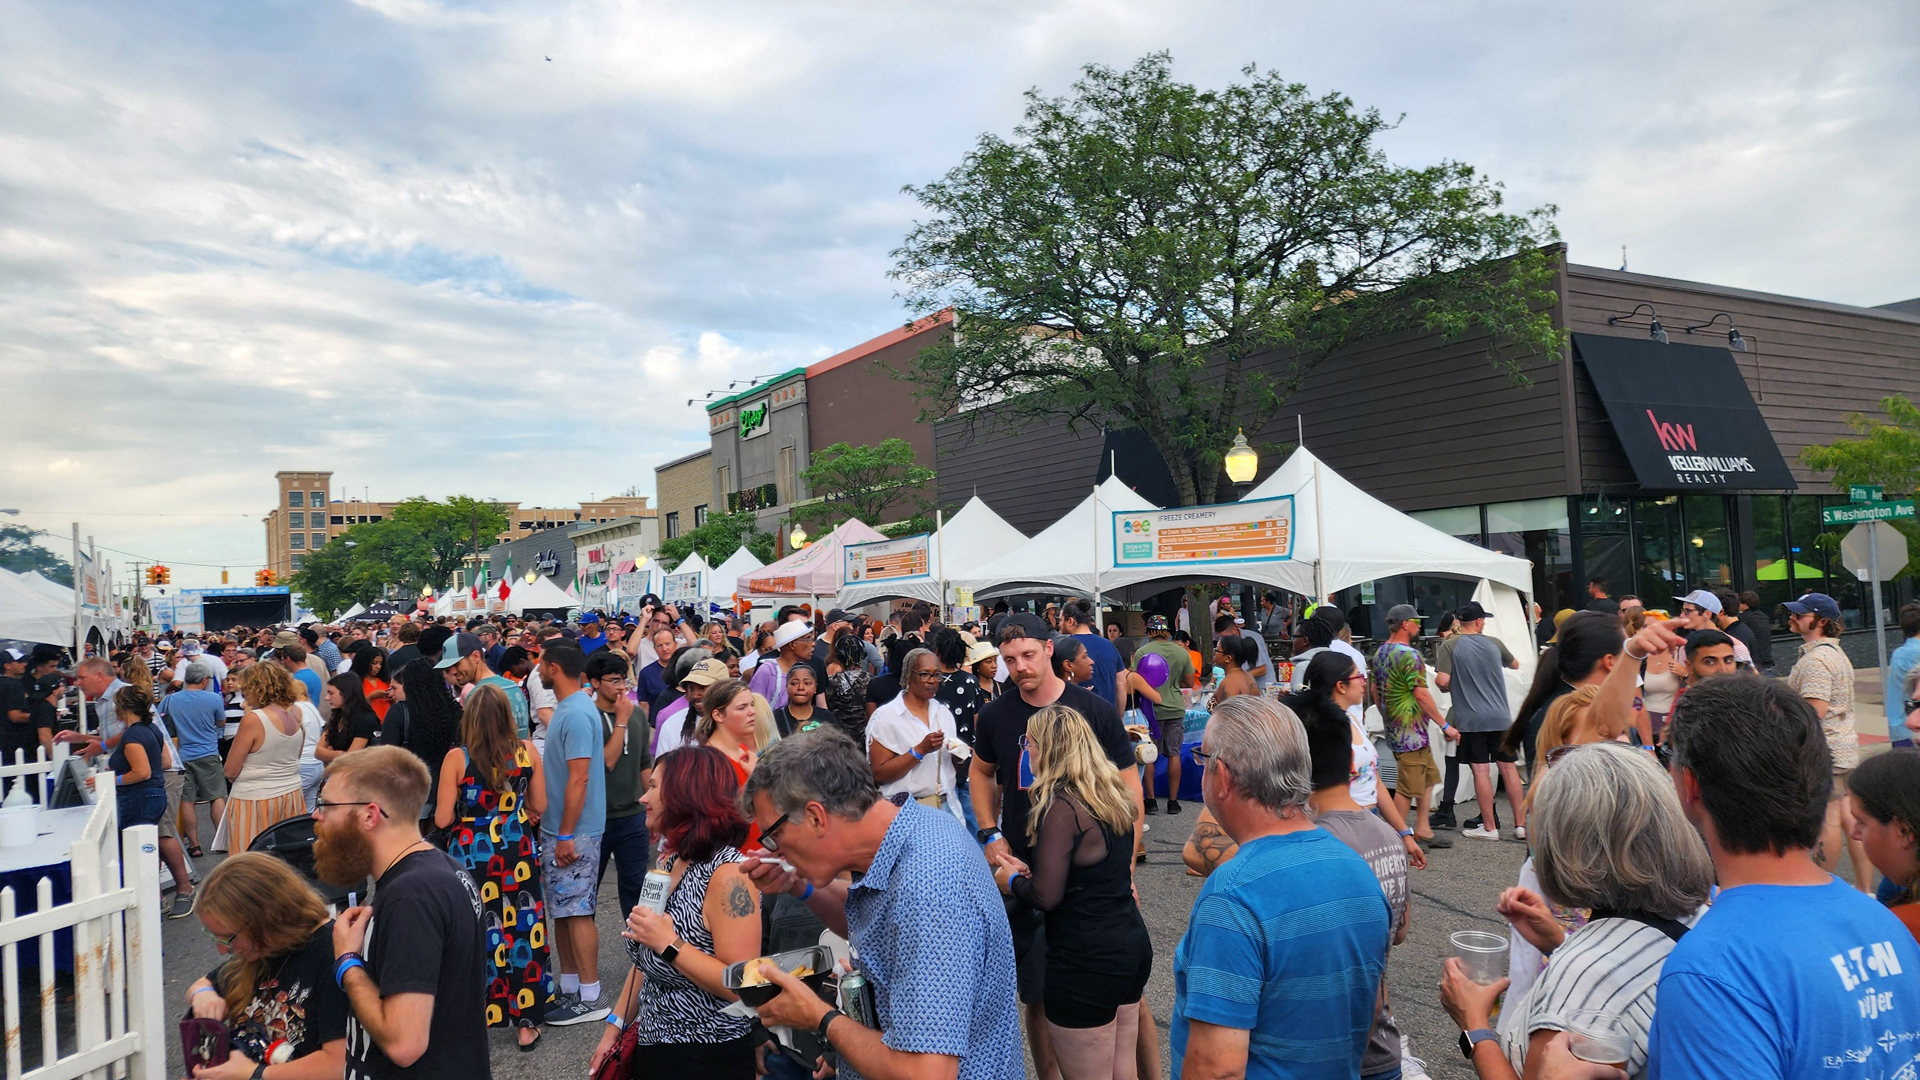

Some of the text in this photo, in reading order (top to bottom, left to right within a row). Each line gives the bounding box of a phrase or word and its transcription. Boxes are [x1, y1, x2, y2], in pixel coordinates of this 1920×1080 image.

[1646, 409, 1697, 451] kw
[1676, 473, 1726, 484] REALTY
[1851, 488, 1882, 501] Fifth Ave
[1184, 511, 1217, 521] CREAMERY
[1823, 504, 1915, 522] S. Washington Ave
[643, 877, 664, 892] Liquid
[641, 888, 662, 901] Death
[1857, 987, 1895, 1020] ijer
